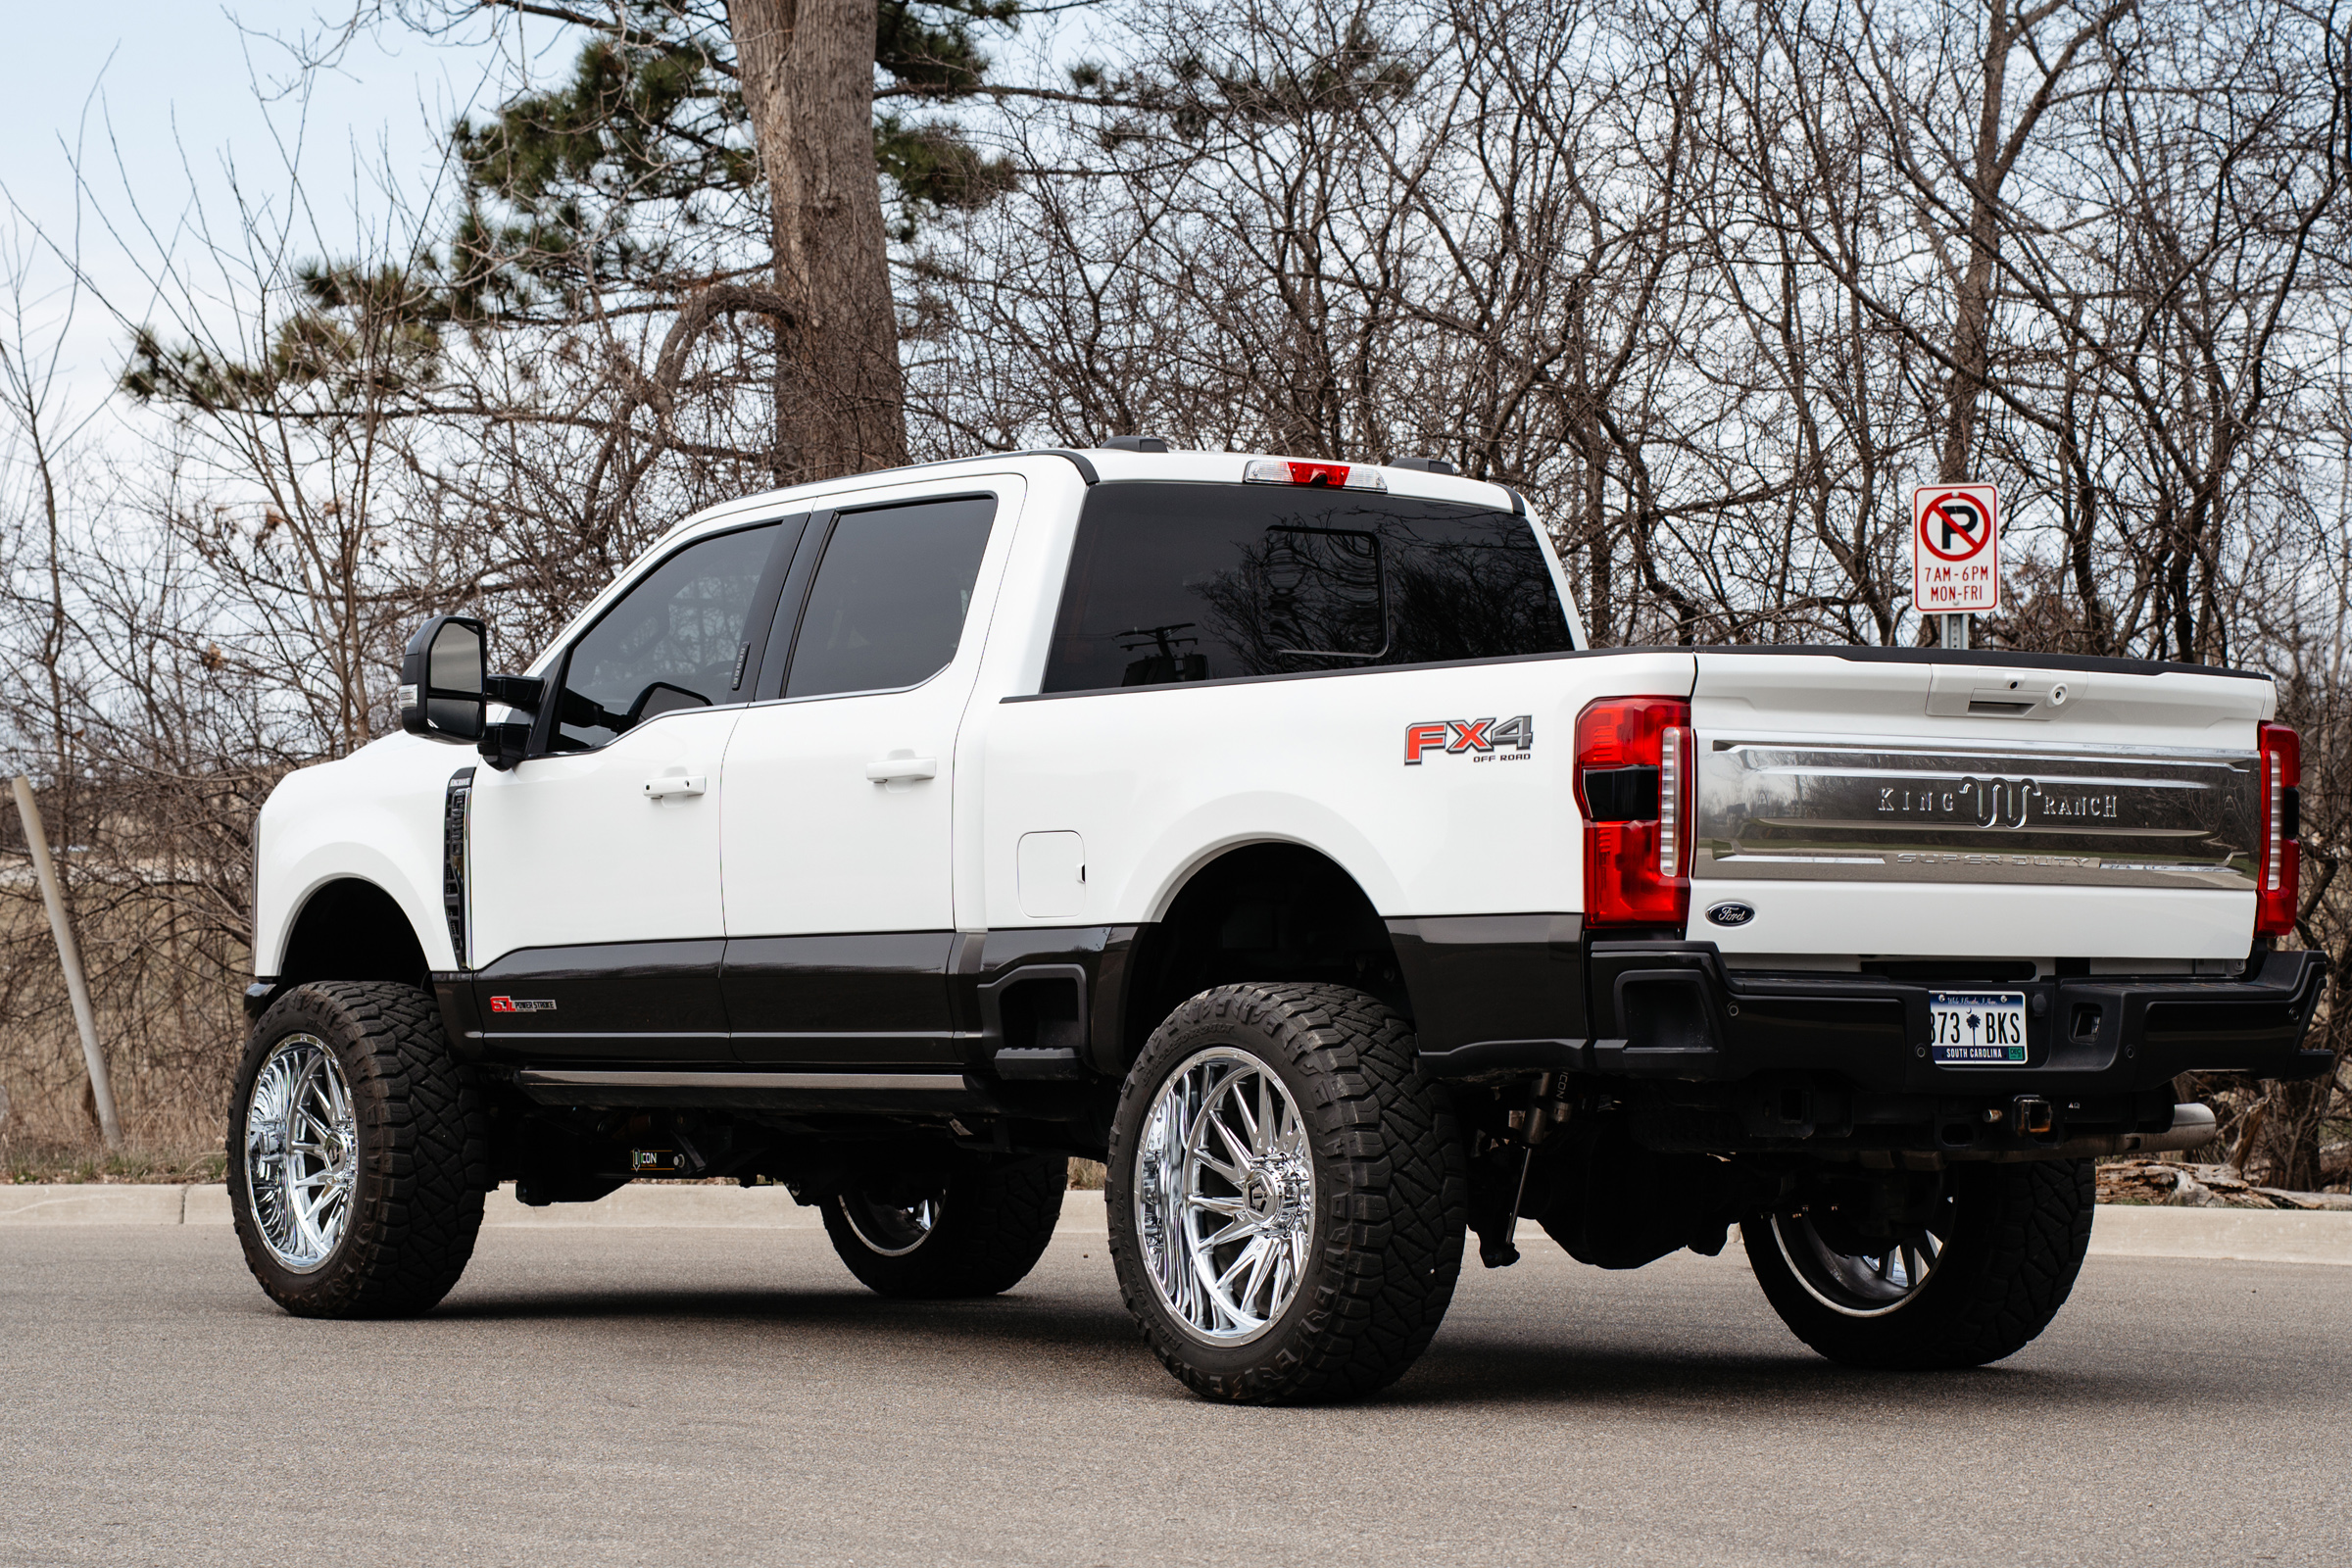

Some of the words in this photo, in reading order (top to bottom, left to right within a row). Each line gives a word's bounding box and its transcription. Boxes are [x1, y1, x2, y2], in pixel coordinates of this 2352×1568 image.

[1931, 585, 1983, 602] MON-FRI
[1404, 714, 1533, 766] FX4
[1878, 787, 1954, 811] KING
[2043, 795, 2118, 818] RANCH
[1896, 853, 2003, 866] SUPER
[2011, 856, 2091, 868] DUTY
[1718, 906, 1745, 921] Ford
[491, 996, 516, 1012] 6.7L
[514, 1001, 533, 1010] POWER
[533, 1001, 555, 1010] STROKE
[1985, 1011, 2021, 1045] BKS
[1946, 1048, 1968, 1058] SOUTH
[1969, 1048, 2002, 1058] CAROLINA
[1556, 1071, 1569, 1099] ICON
